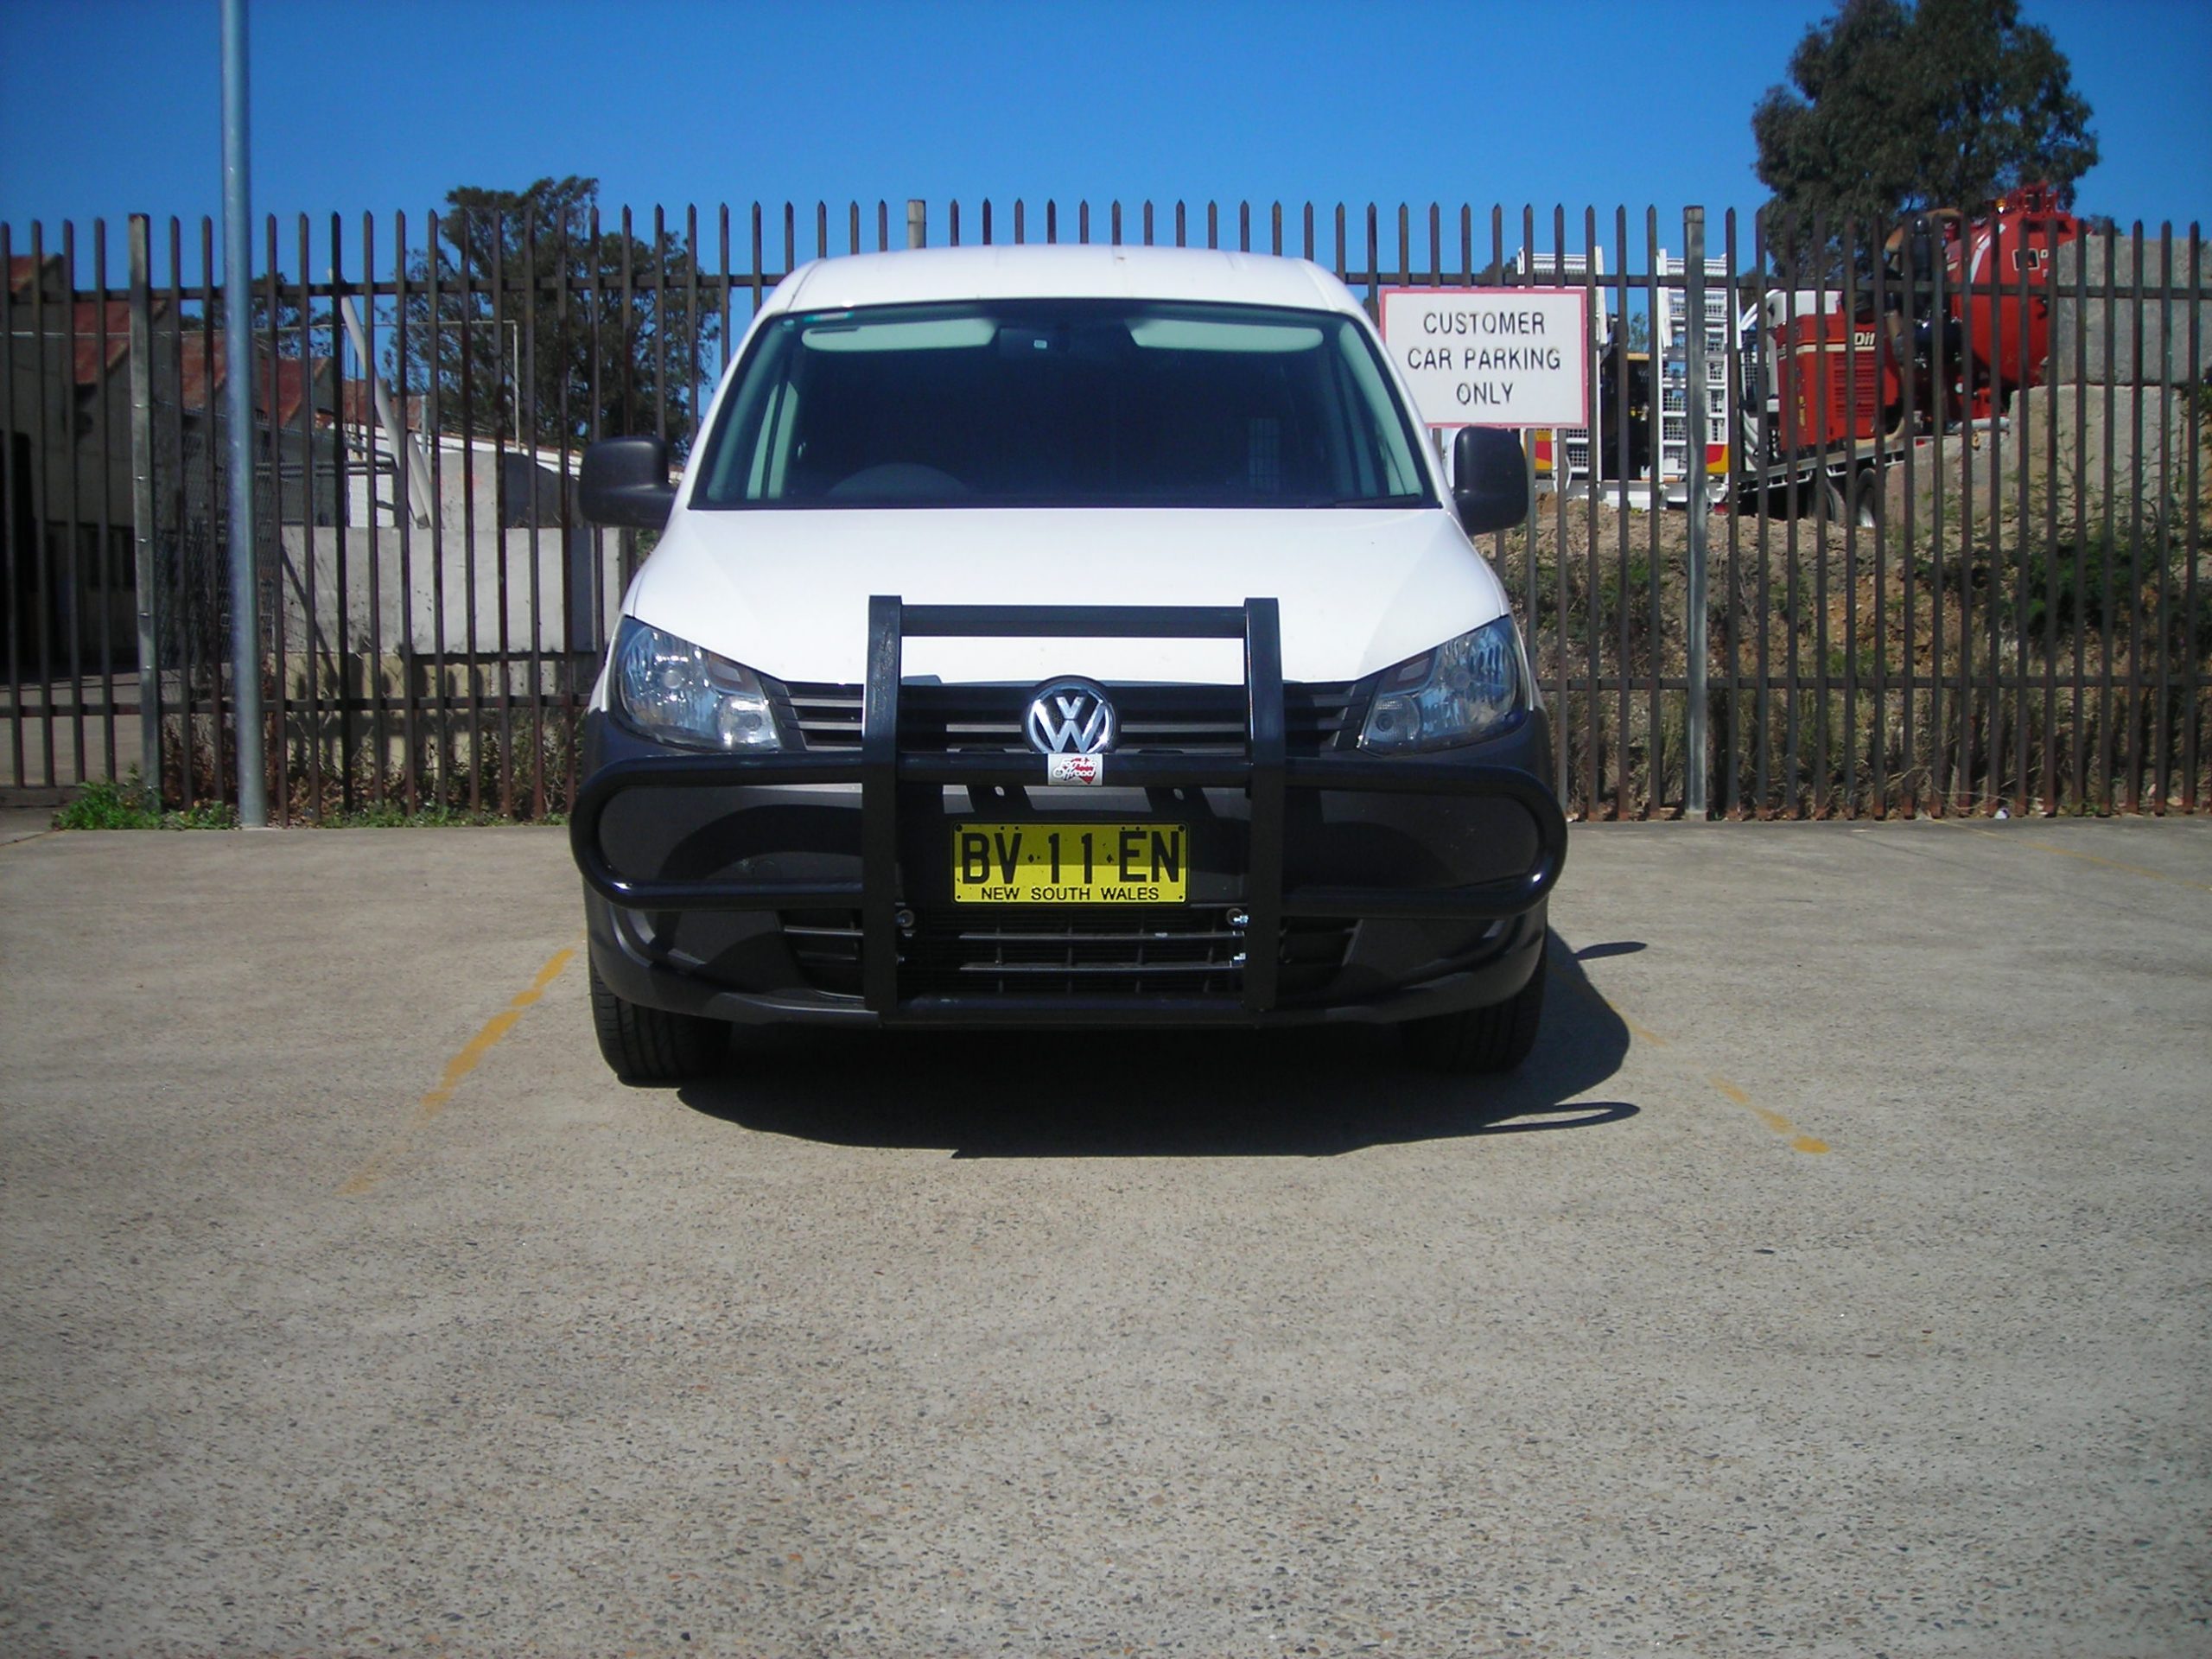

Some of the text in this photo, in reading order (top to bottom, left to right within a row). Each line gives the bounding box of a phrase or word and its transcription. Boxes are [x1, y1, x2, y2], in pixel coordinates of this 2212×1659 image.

[1423, 312, 1545, 335] CUSTOMER
[1407, 347, 1561, 371] CAR PARKING
[1456, 382, 1514, 405] ONLY
[981, 887, 1160, 900] NEW SOUTH WALES
